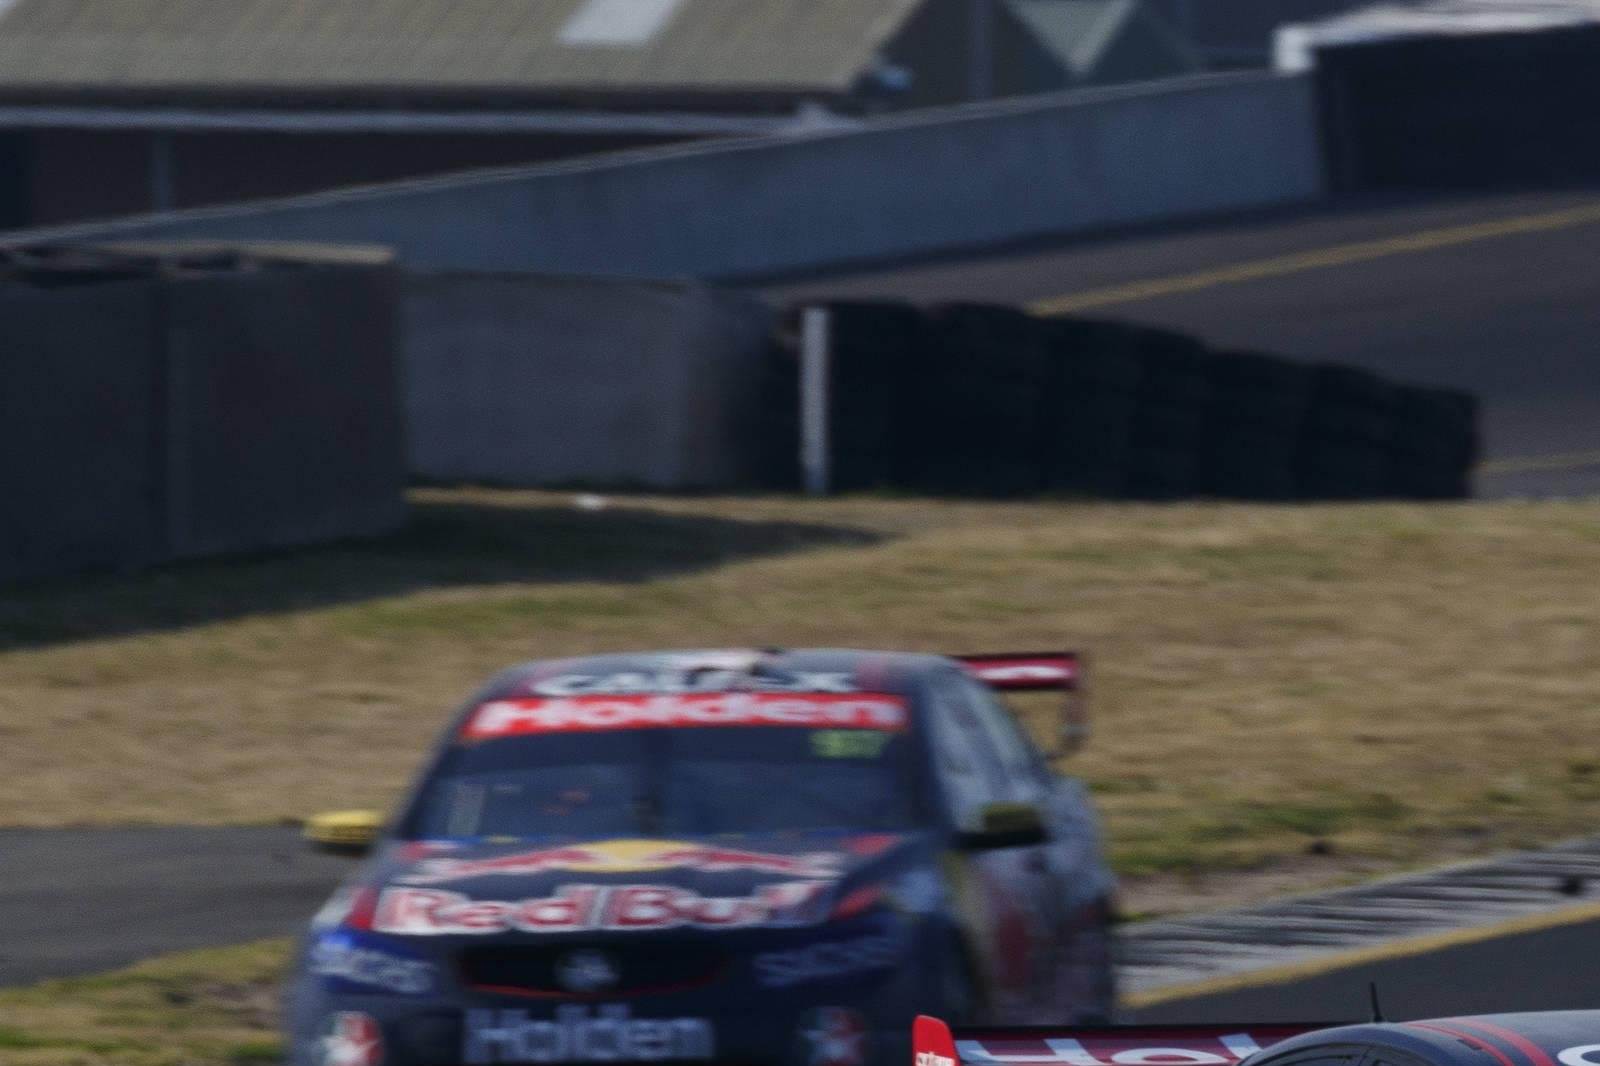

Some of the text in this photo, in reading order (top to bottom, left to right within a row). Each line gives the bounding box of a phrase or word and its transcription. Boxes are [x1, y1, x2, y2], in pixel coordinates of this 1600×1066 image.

[472, 695, 903, 736] Holden
[373, 880, 838, 935] Red Bull
[463, 1003, 714, 1064] Holden
